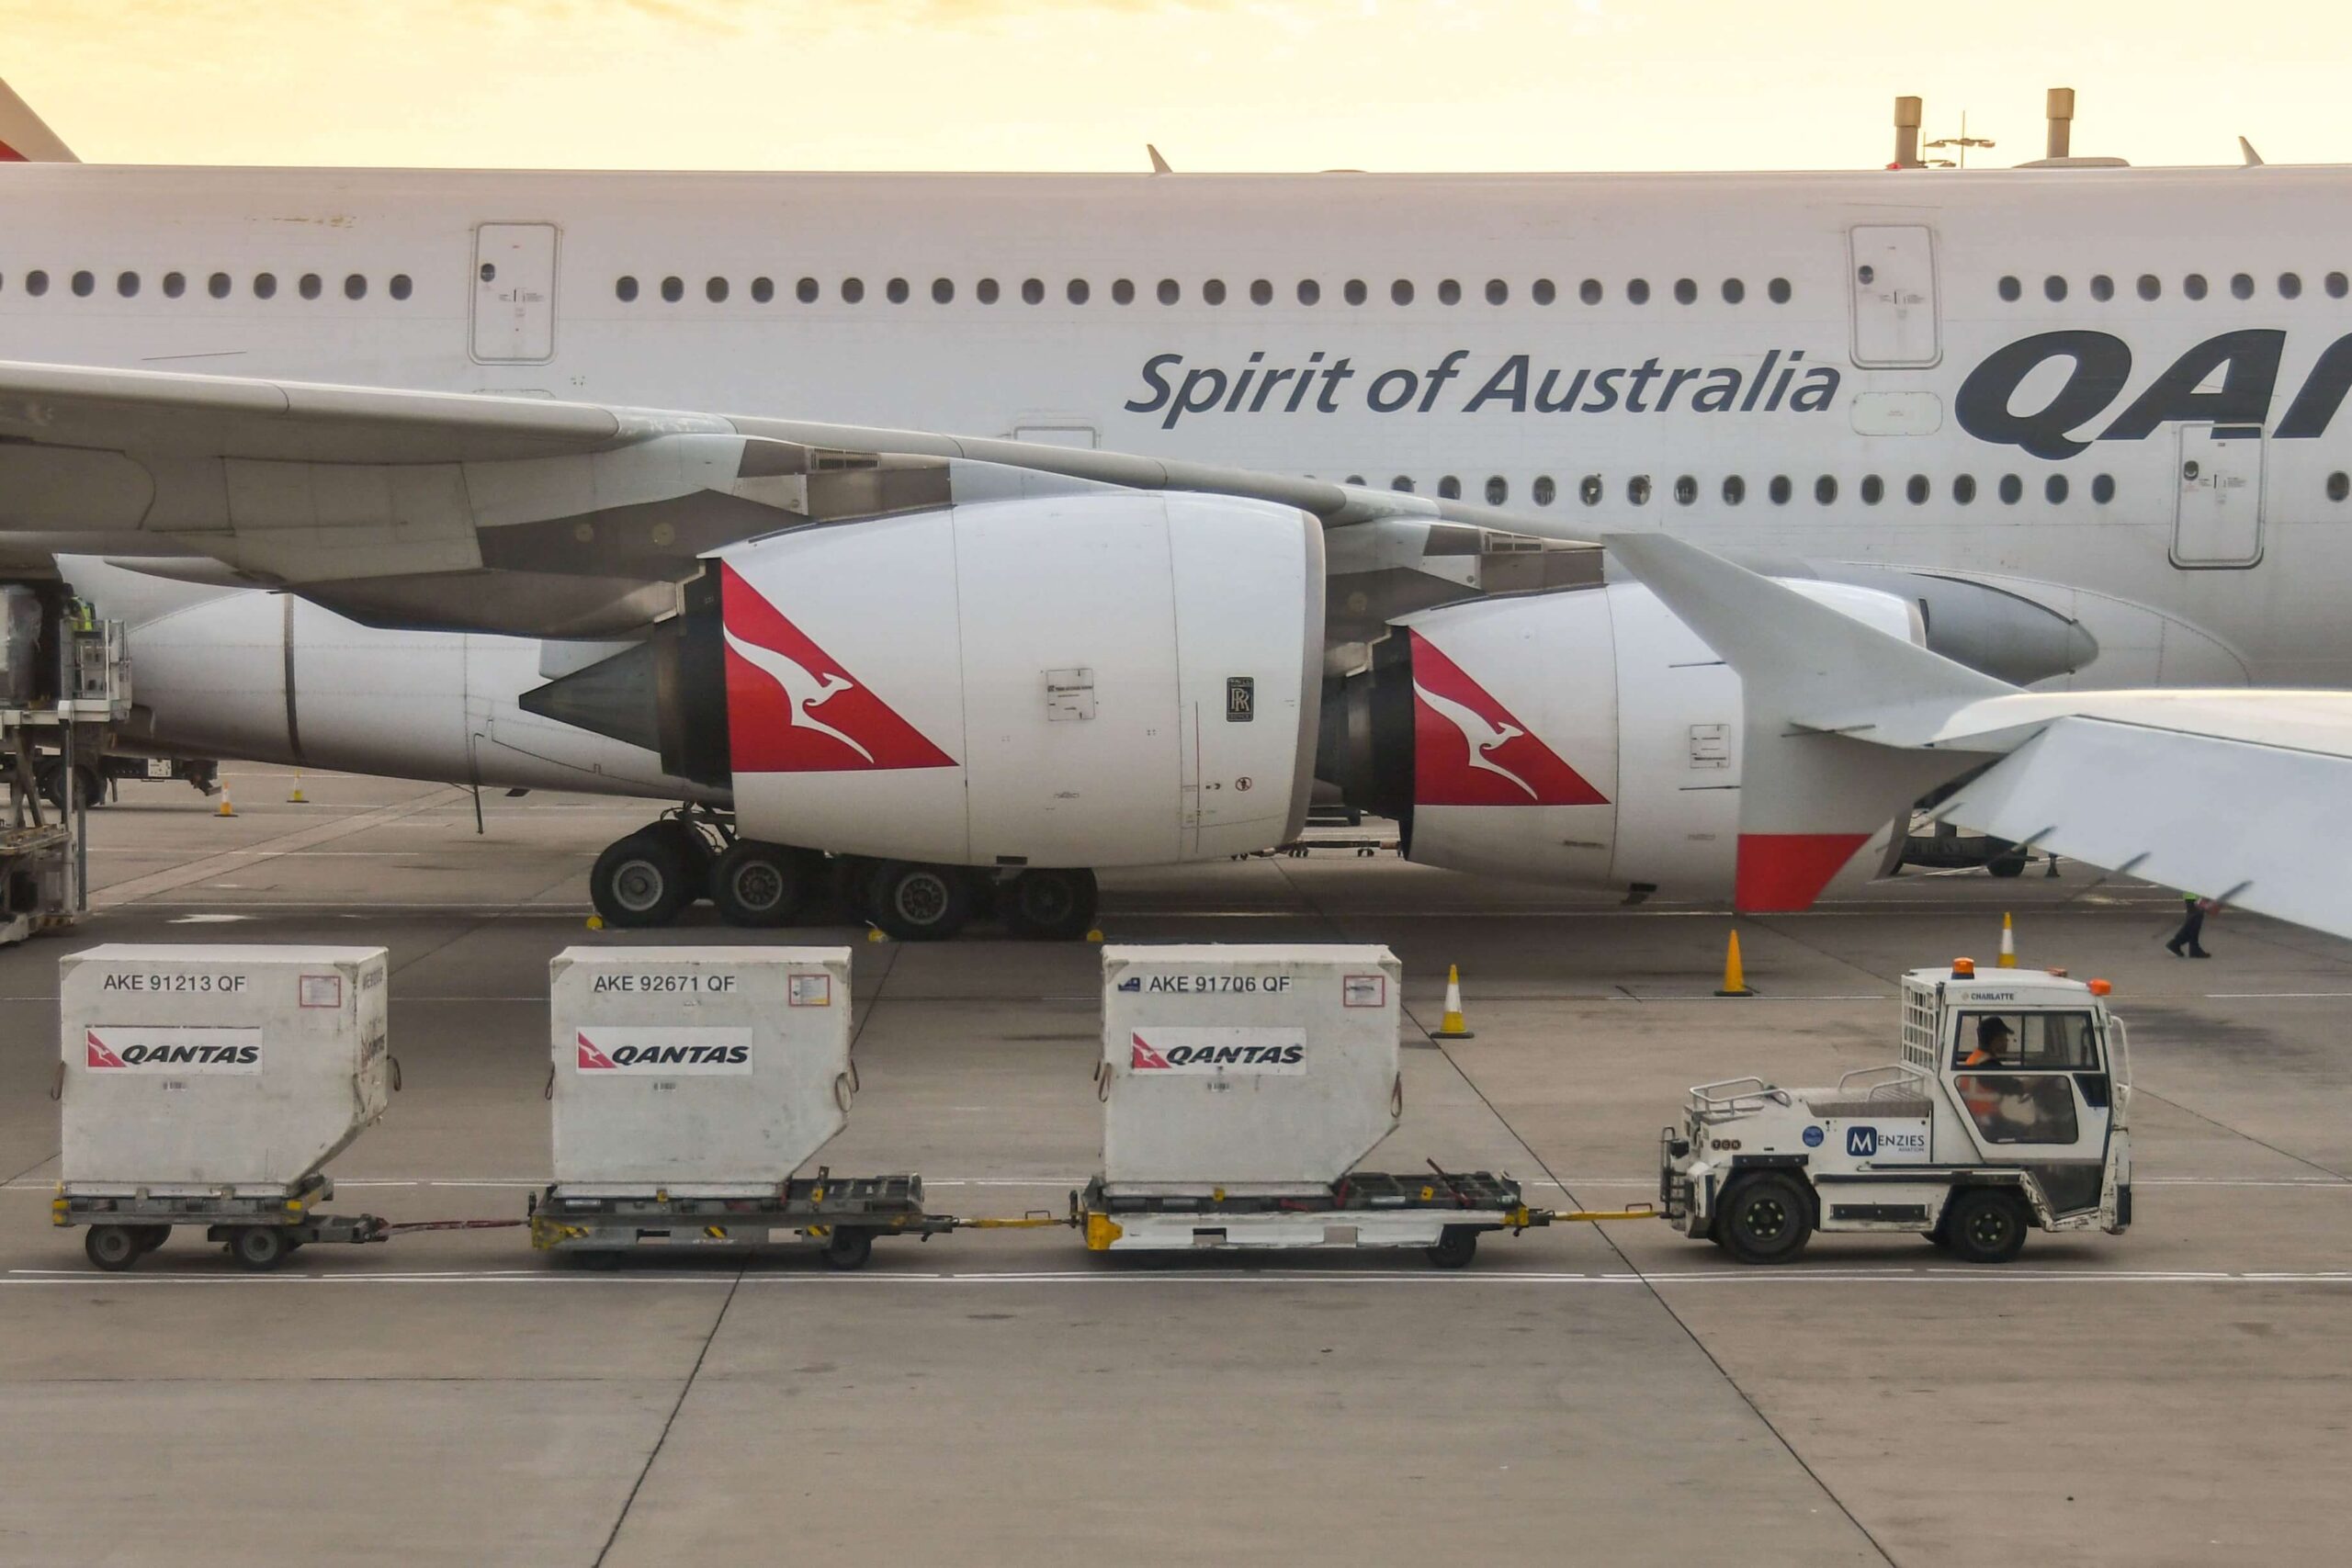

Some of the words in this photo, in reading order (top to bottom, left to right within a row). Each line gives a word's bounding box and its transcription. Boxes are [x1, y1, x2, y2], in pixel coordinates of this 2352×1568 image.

[1124, 350, 1355, 430] Spirit
[1366, 350, 1470, 413] of
[1461, 349, 1841, 413] Australia
[103, 974, 143, 990] AKE
[150, 975, 211, 991] 91213
[218, 976, 246, 992] QF
[594, 976, 634, 992] AKE
[640, 976, 699, 991] 92671
[707, 976, 735, 992] QF
[1149, 976, 1189, 992] AKE
[1195, 976, 1256, 992] 91706
[1262, 976, 1291, 992] QF
[1971, 992, 2015, 1000] CHARLATTE
[121, 1044, 260, 1066] QANTAS
[611, 1045, 750, 1066] QANTAS
[1166, 1045, 1304, 1066] QANTAS
[1850, 1131, 1925, 1153] MENZIES
